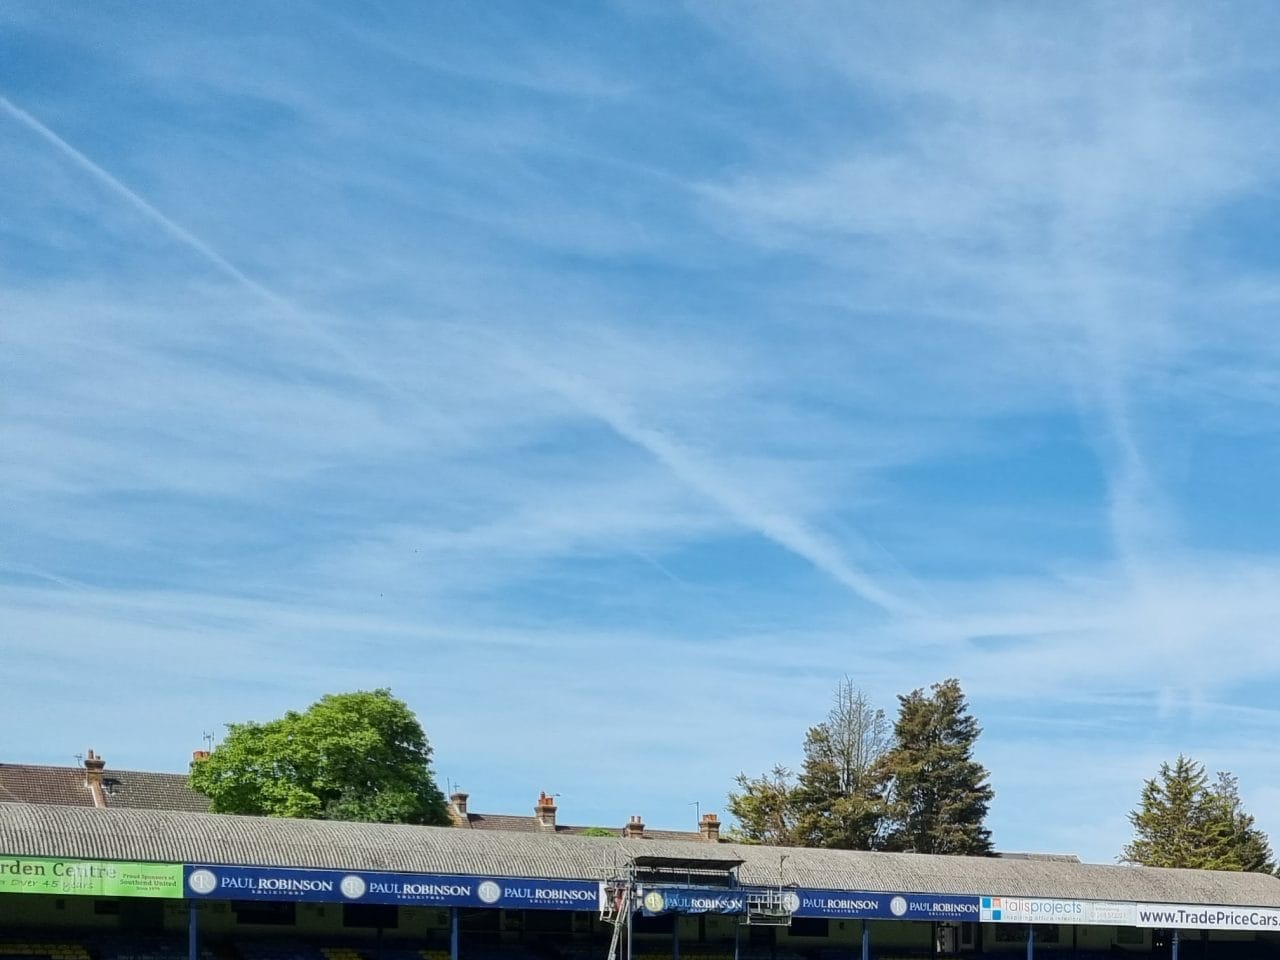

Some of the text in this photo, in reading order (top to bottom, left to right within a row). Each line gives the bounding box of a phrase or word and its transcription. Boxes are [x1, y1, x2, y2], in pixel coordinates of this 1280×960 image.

[53, 862, 116, 879] Centre
[222, 877, 333, 891] PAUL ROBINSON
[370, 882, 471, 896] PAUL ROBINSON
[504, 887, 596, 900] PAUL ROBINSON
[666, 898, 743, 909] PAUL ROBINSON
[802, 898, 879, 910] PAUL ROBINSON
[910, 902, 979, 913] PAUL ROBINSON
